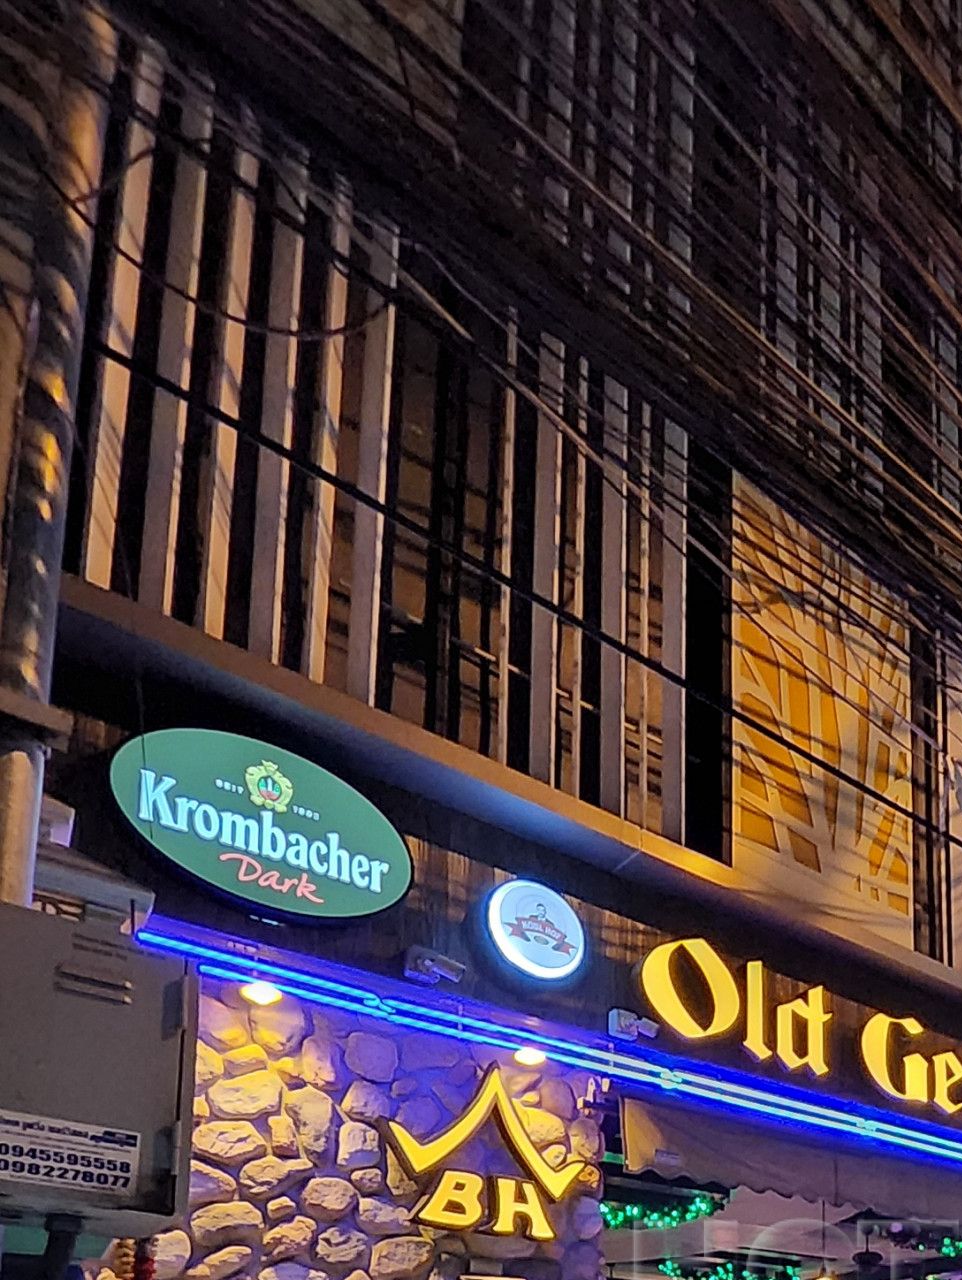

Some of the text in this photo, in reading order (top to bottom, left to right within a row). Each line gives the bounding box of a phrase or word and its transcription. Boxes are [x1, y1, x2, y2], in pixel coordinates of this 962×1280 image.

[139, 767, 390, 894] Krombacher
[219, 851, 324, 904] Dark
[641, 937, 832, 1076] Old
[0, 1143, 131, 1173] 0945595558
[420, 1171, 555, 1240] BH
